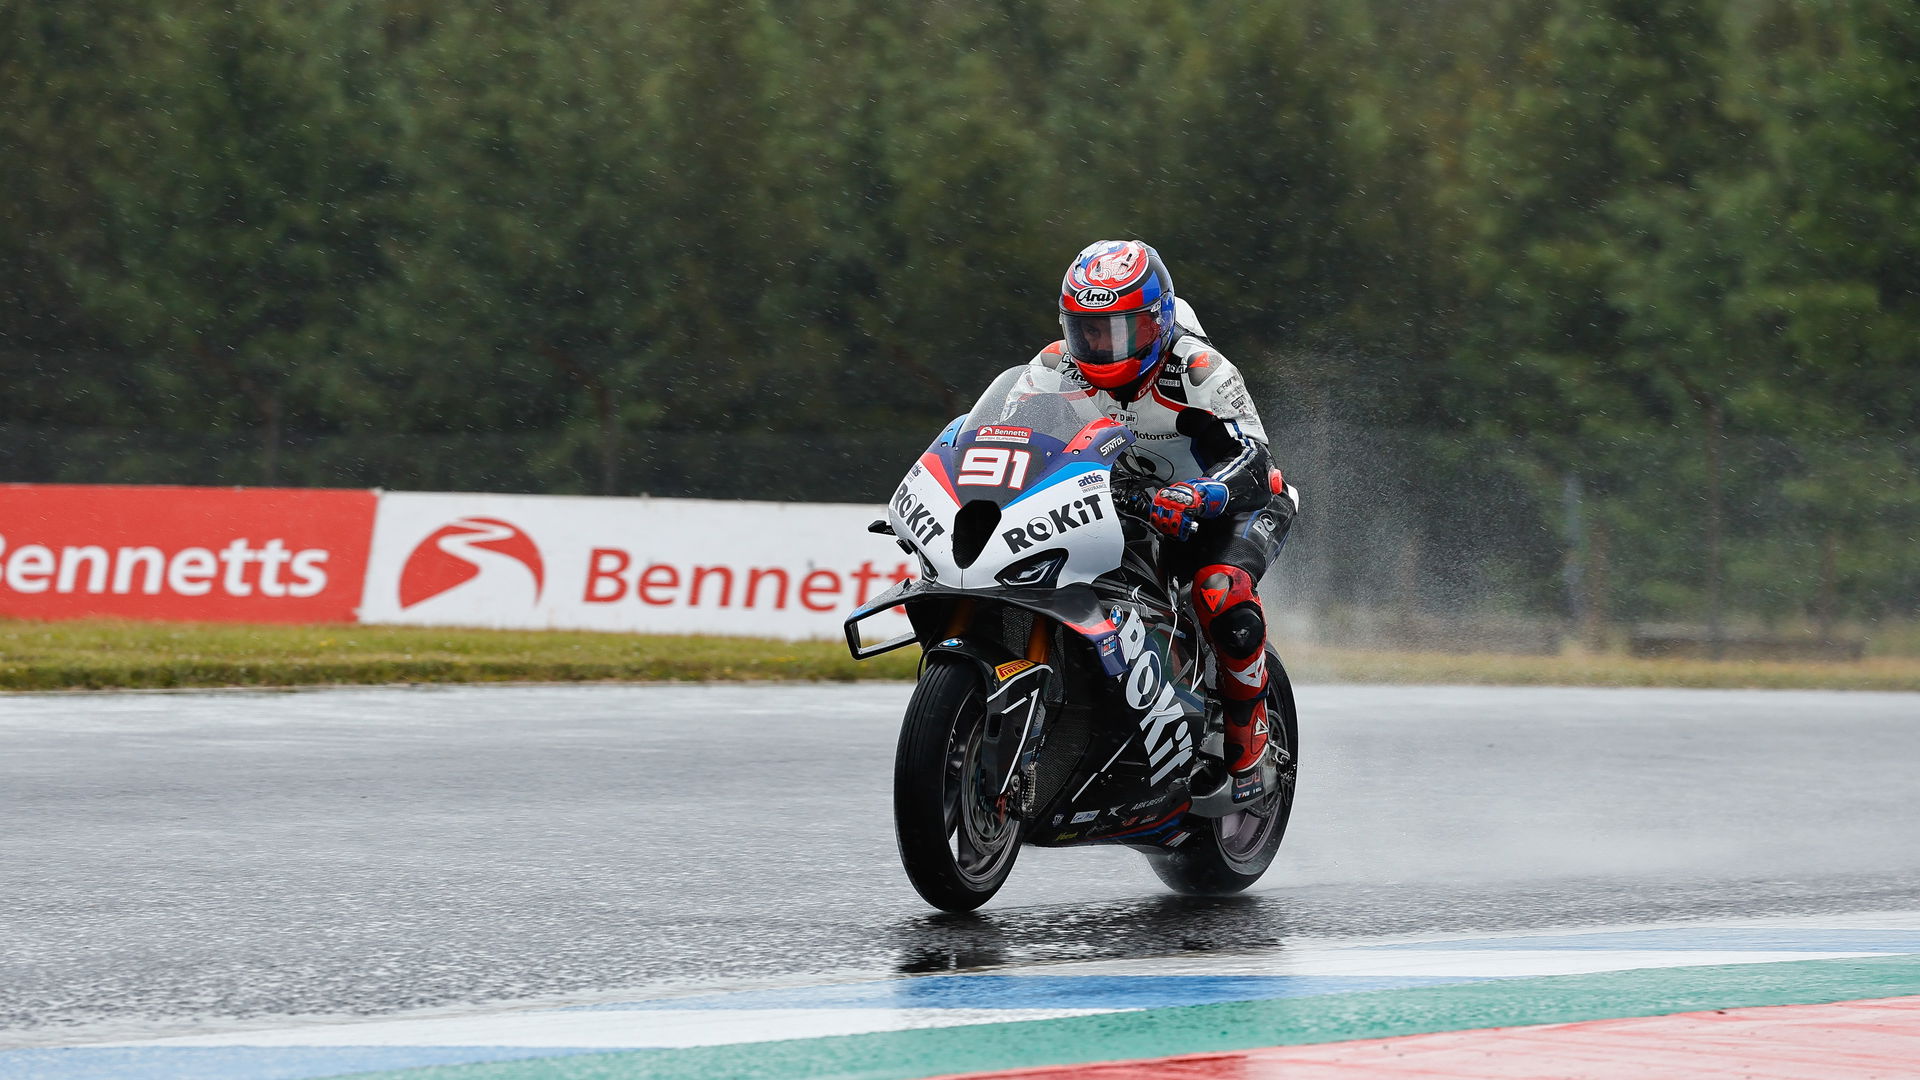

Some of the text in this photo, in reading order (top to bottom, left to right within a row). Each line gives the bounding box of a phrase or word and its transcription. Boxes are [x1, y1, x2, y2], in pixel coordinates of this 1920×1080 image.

[1078, 290, 1112, 302] Arai
[994, 428, 1028, 437] Bennetts
[1099, 434, 1126, 456] SYNTOL
[957, 447, 1032, 490] 91
[1078, 472, 1104, 488] attis
[1001, 494, 1104, 555] ROKiT
[0, 532, 330, 598] ennetts
[582, 546, 916, 617] Bennett
[998, 660, 1031, 678] PIRELLI
